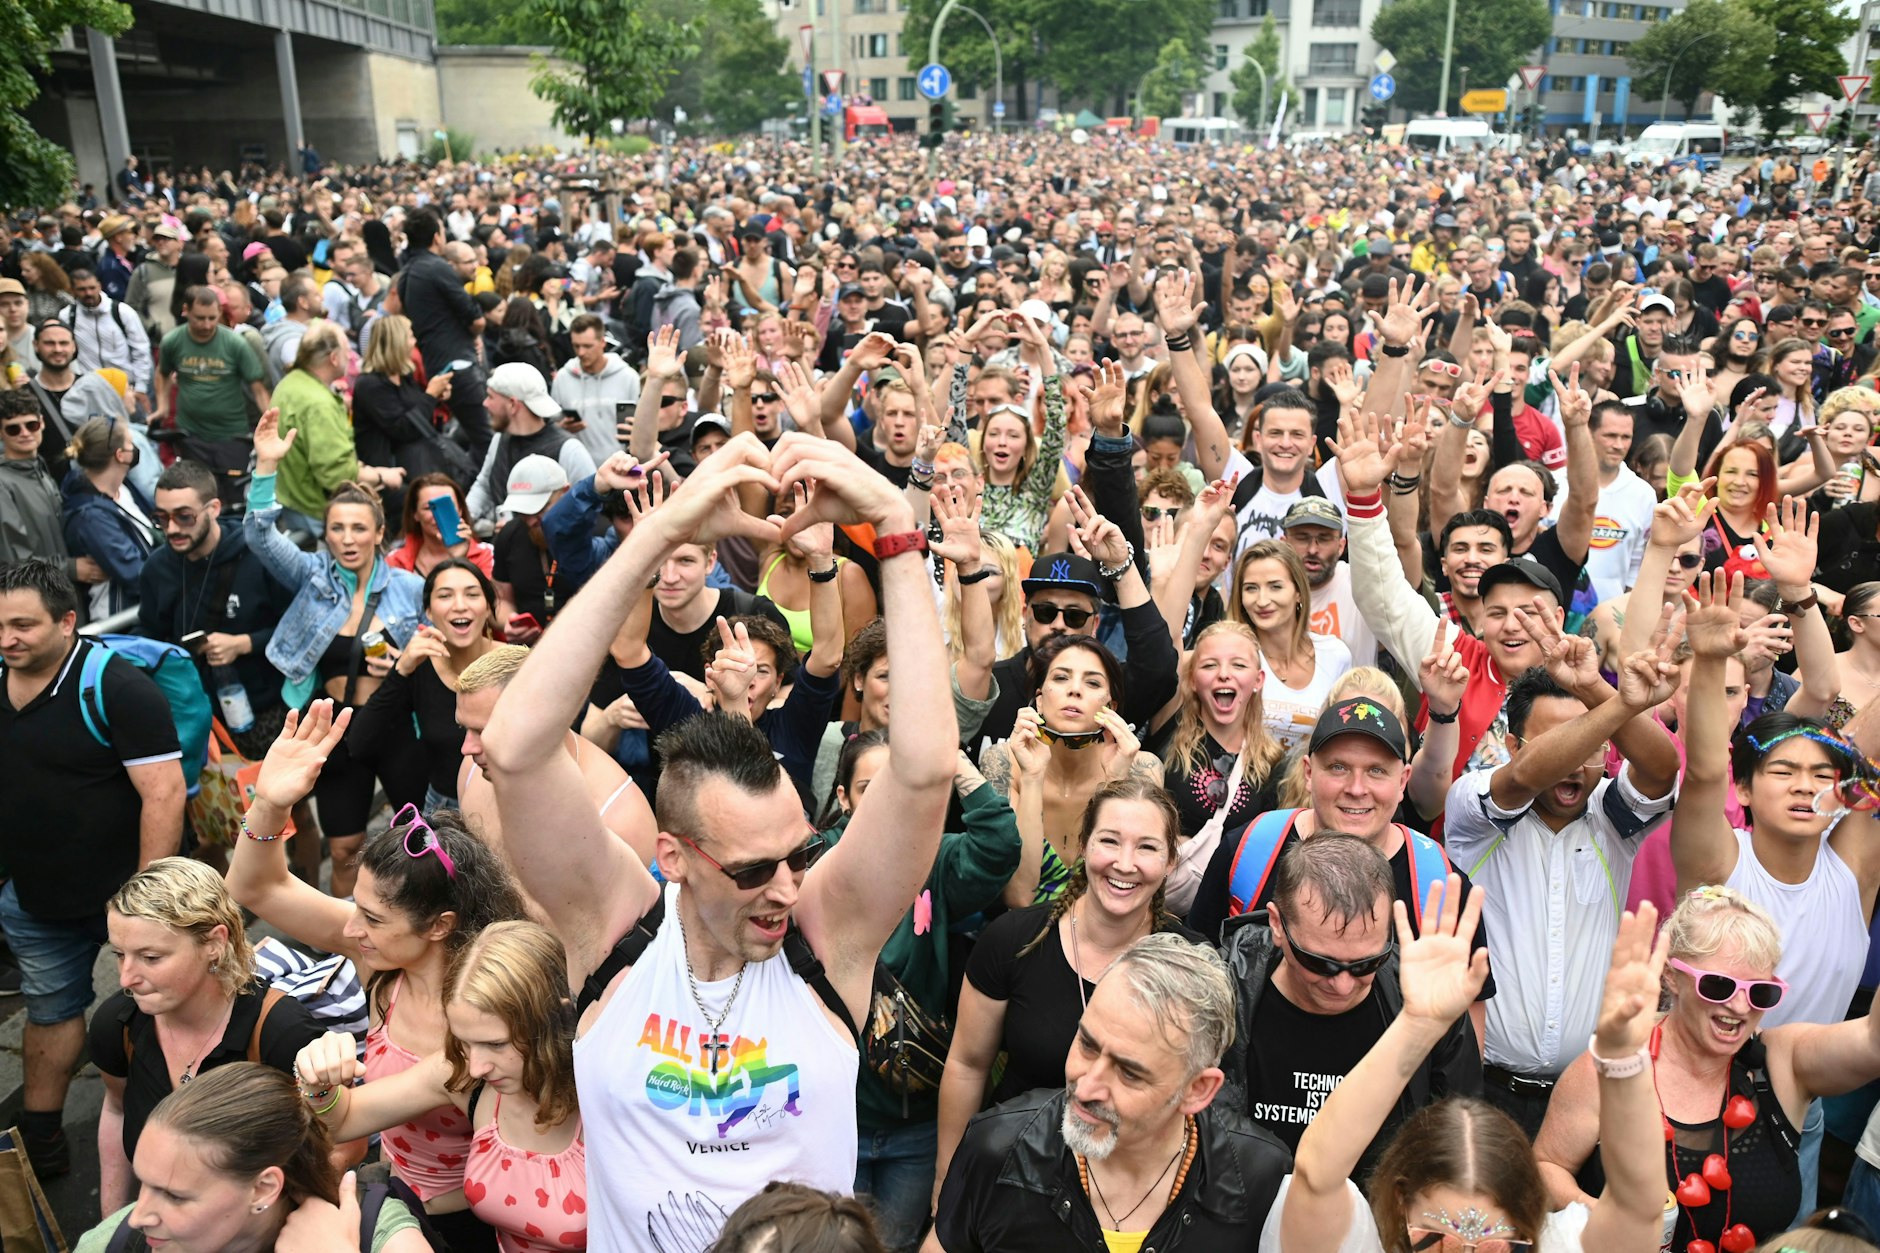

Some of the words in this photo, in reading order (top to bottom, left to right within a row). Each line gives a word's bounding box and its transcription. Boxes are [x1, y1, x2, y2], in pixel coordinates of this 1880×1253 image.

[1591, 528, 1625, 538] ckies
[1049, 559, 1071, 581] NY
[636, 1013, 693, 1064] ALL
[648, 1075, 670, 1088] Hard
[669, 1080, 690, 1095] Rock
[1306, 1091, 1328, 1108] IST
[1254, 1103, 1318, 1125] SYSTEMR
[686, 1141, 750, 1154] VENICE
